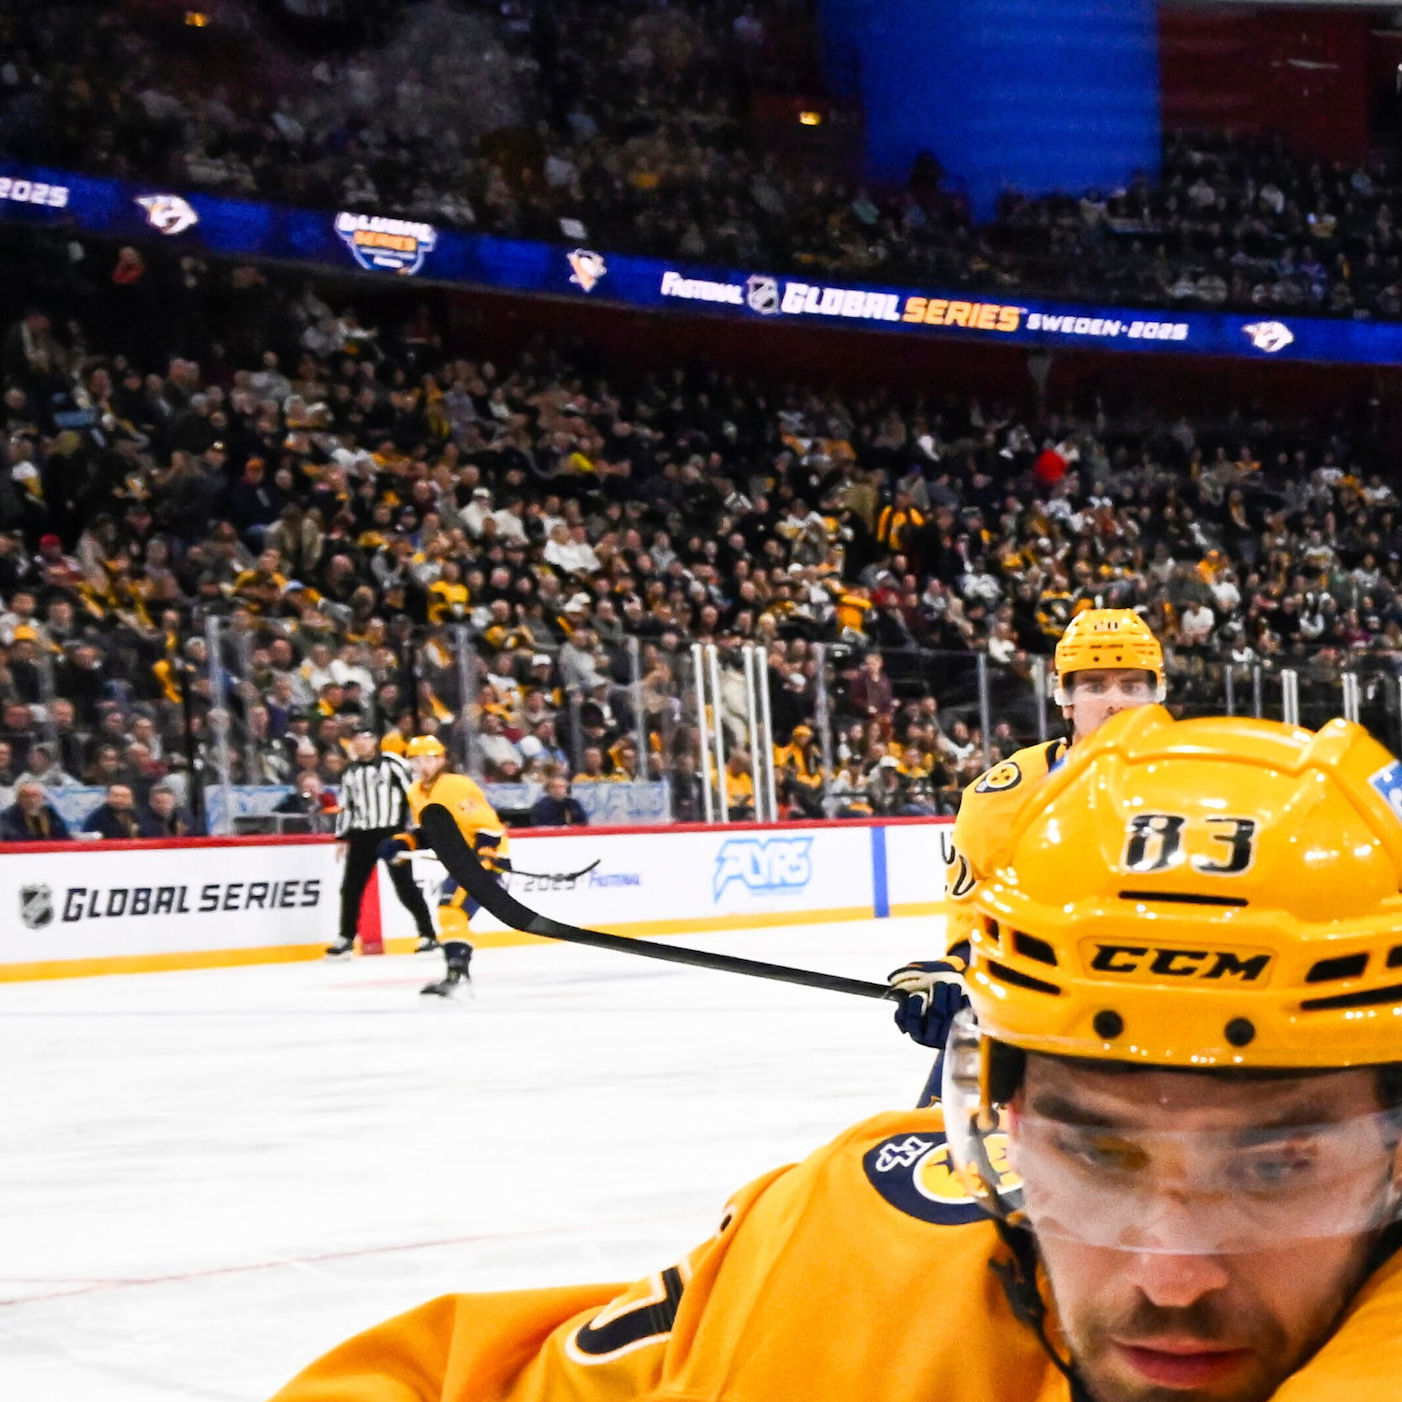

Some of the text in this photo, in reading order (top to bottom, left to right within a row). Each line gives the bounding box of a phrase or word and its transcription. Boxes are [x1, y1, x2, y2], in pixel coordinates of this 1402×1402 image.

[782, 283, 898, 321] GLOBAL
[903, 297, 1021, 332] SERIES
[1124, 813, 1257, 874] 83
[63, 879, 320, 923] GLOBAL SERIES
[1090, 944, 1273, 982] CCM
